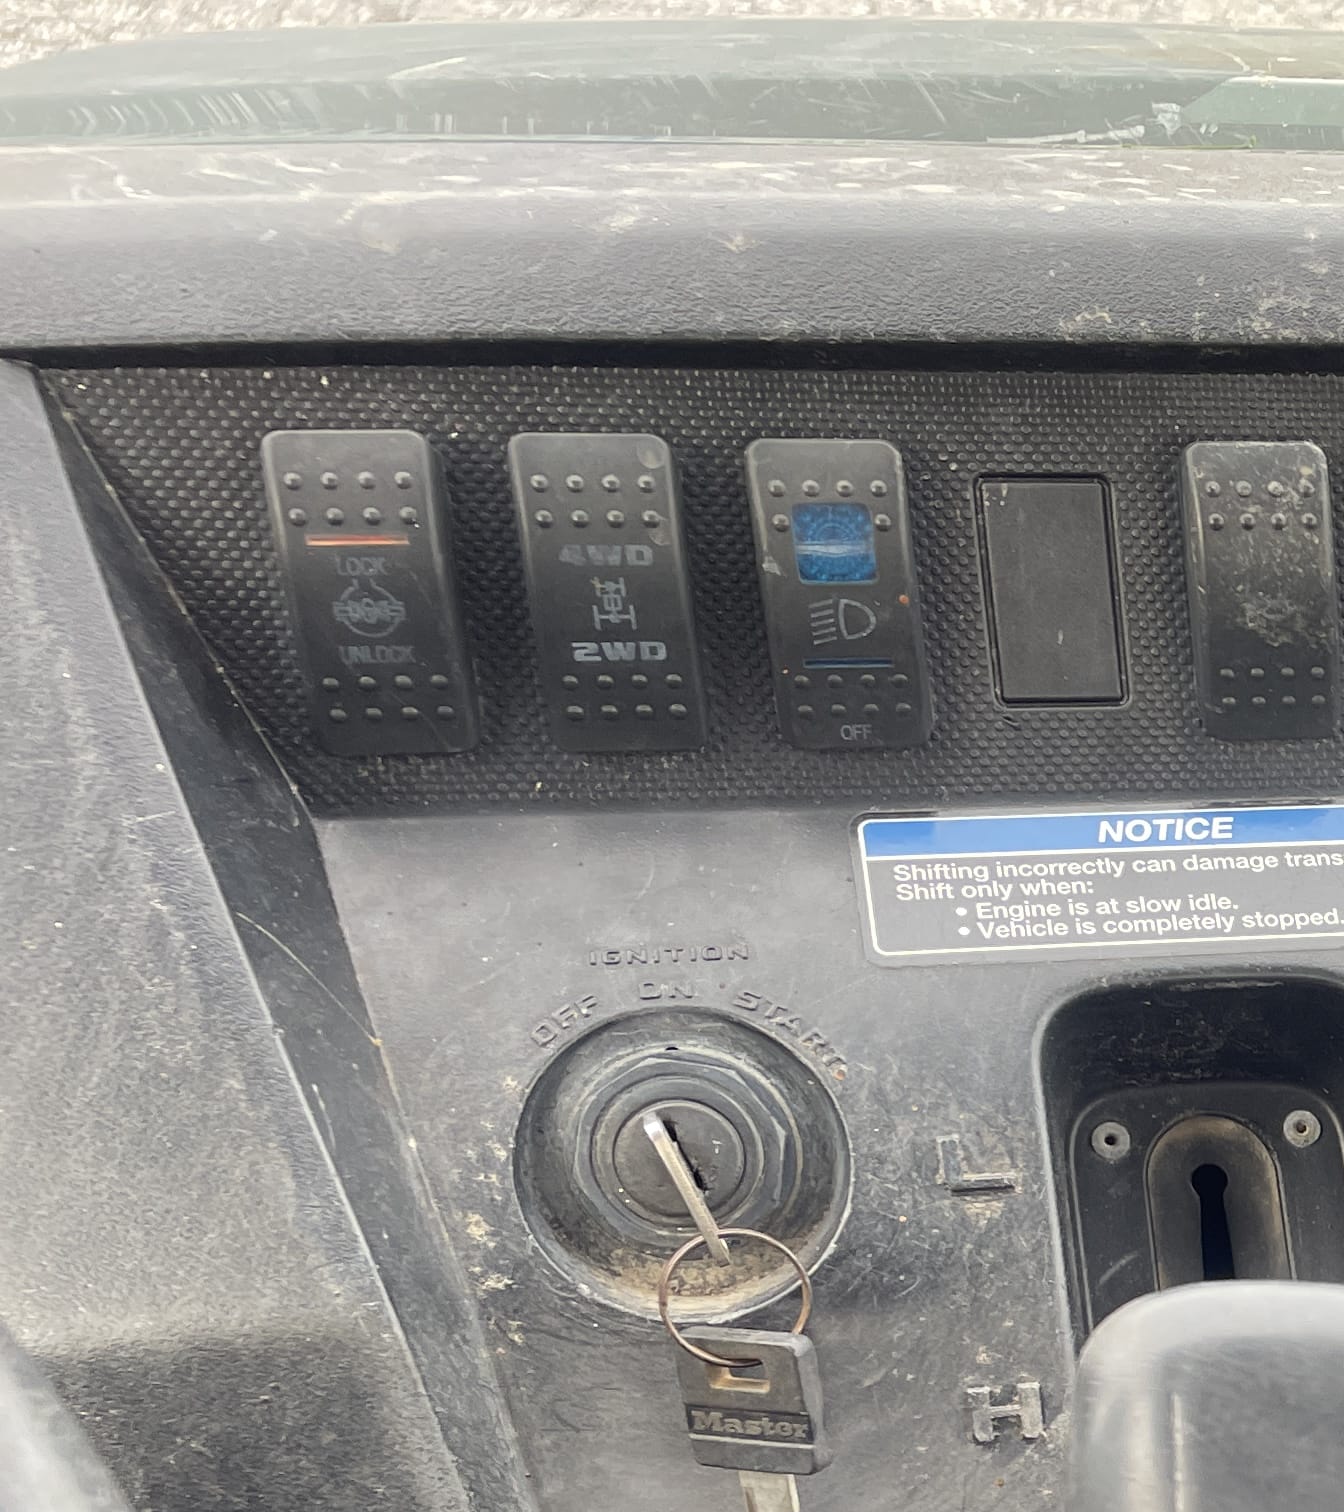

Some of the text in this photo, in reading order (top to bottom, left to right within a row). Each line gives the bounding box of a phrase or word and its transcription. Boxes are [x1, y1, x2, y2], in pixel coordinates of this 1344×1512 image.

[335, 556, 389, 576] LOCK
[558, 543, 654, 567] 4WD
[339, 645, 417, 664] UNLOCK
[571, 641, 667, 662] 2WD
[840, 724, 872, 741] OFF
[1098, 815, 1235, 844] NOTICE
[893, 861, 989, 883] Shifting
[996, 857, 1126, 879] incorrectly
[1132, 858, 1177, 873] can
[1183, 853, 1279, 873] damage
[896, 878, 1095, 901] Shift only when:
[976, 893, 1239, 921] Engine is at slow idle.
[977, 918, 1069, 939] Vehicle
[1075, 917, 1097, 935] is
[1102, 911, 1235, 936] completely
[588, 944, 751, 967] IGNITION
[637, 981, 696, 1000] ON
[529, 993, 600, 1048] OFF
[733, 989, 849, 1073] START
[935, 1134, 1018, 1193] L
[690, 1410, 811, 1439] Master
[966, 1379, 1046, 1443] H
